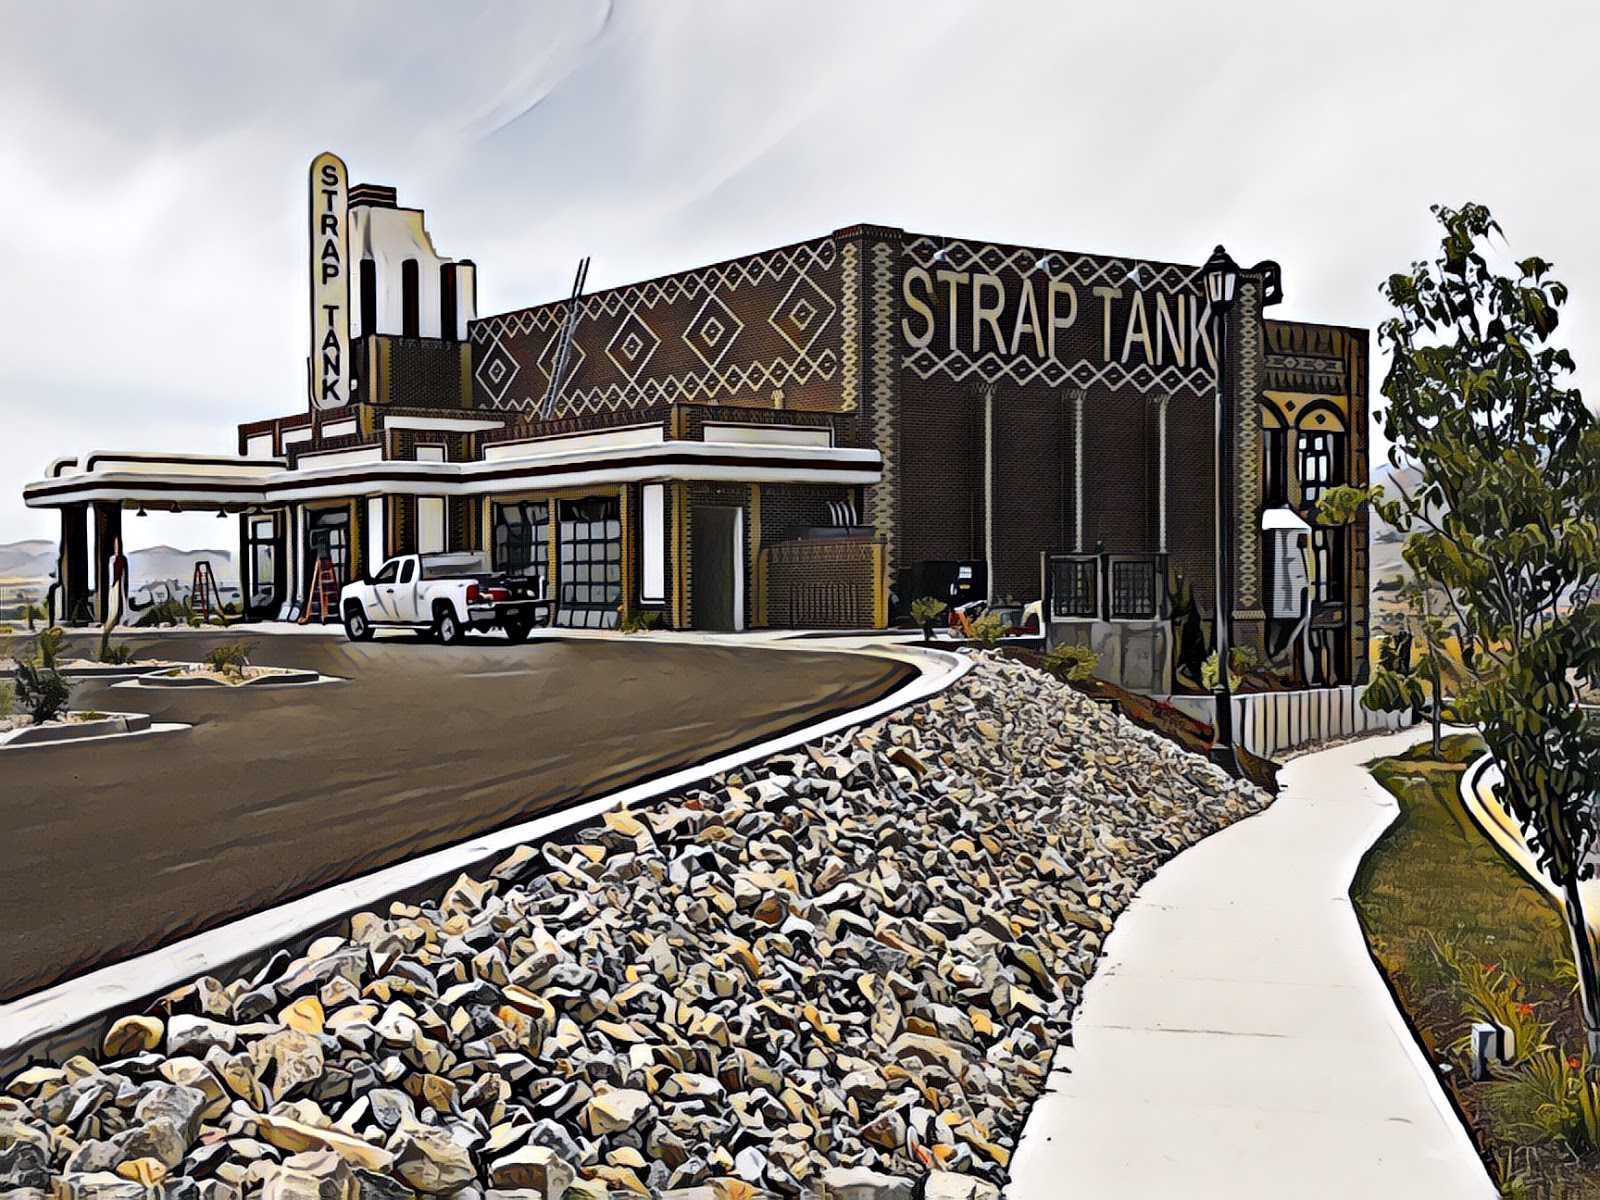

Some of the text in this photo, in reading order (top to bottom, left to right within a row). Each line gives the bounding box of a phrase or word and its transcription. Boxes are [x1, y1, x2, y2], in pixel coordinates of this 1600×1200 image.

[321, 165, 340, 401] STRAP TANK
[902, 265, 1217, 370] STRAP TANK
